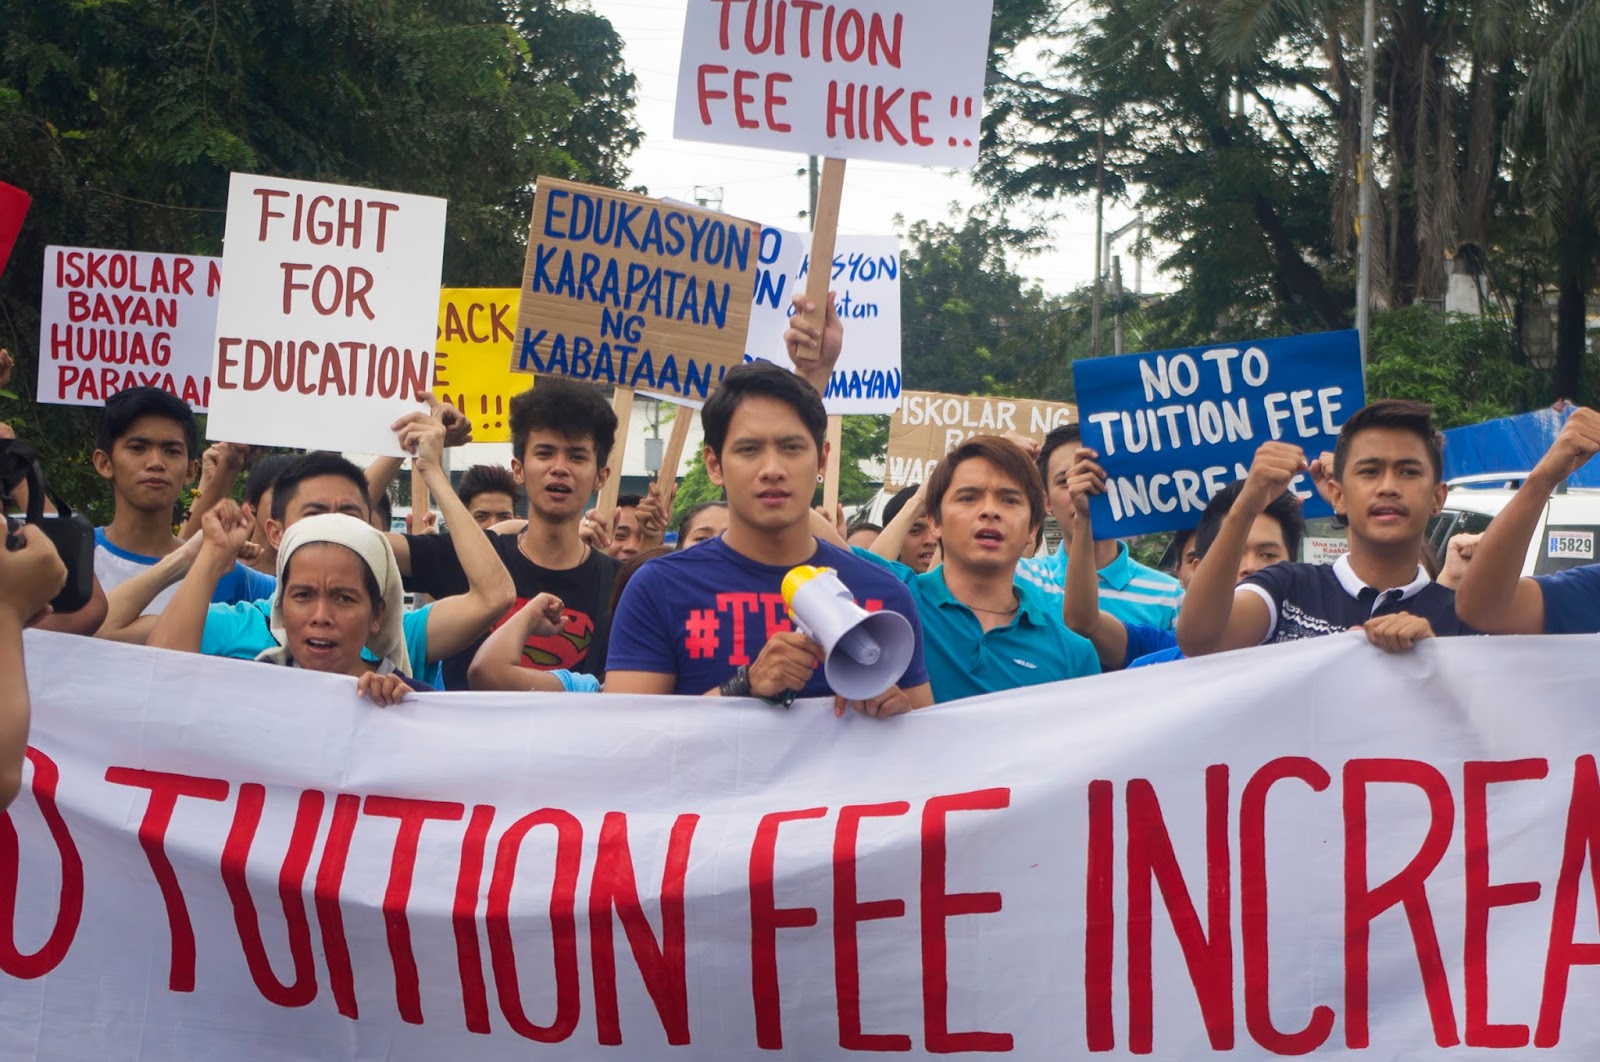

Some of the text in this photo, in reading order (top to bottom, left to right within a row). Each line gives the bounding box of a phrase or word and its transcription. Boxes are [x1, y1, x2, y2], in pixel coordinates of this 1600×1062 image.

[710, 0, 903, 68] TUITION
[697, 64, 793, 132] FEE
[253, 188, 400, 253] FIGHT
[544, 189, 751, 272] EDUKASYON
[56, 250, 194, 296] ISKOLAR
[280, 262, 376, 320] FOR
[532, 243, 730, 329] KARAPATAN
[68, 290, 177, 328] BAYAN
[437, 302, 514, 343] ACK
[601, 307, 646, 344] NG
[51, 323, 172, 367] HUWAG
[218, 337, 430, 402] EDUCATION
[1139, 347, 1269, 403] NO TO
[902, 396, 1017, 431] ISKOLAR
[1088, 386, 1343, 456] TUITION FEE
[1559, 537, 1592, 553] 5829
[104, 765, 700, 1046] TUITION
[748, 787, 1014, 1054] FEE
